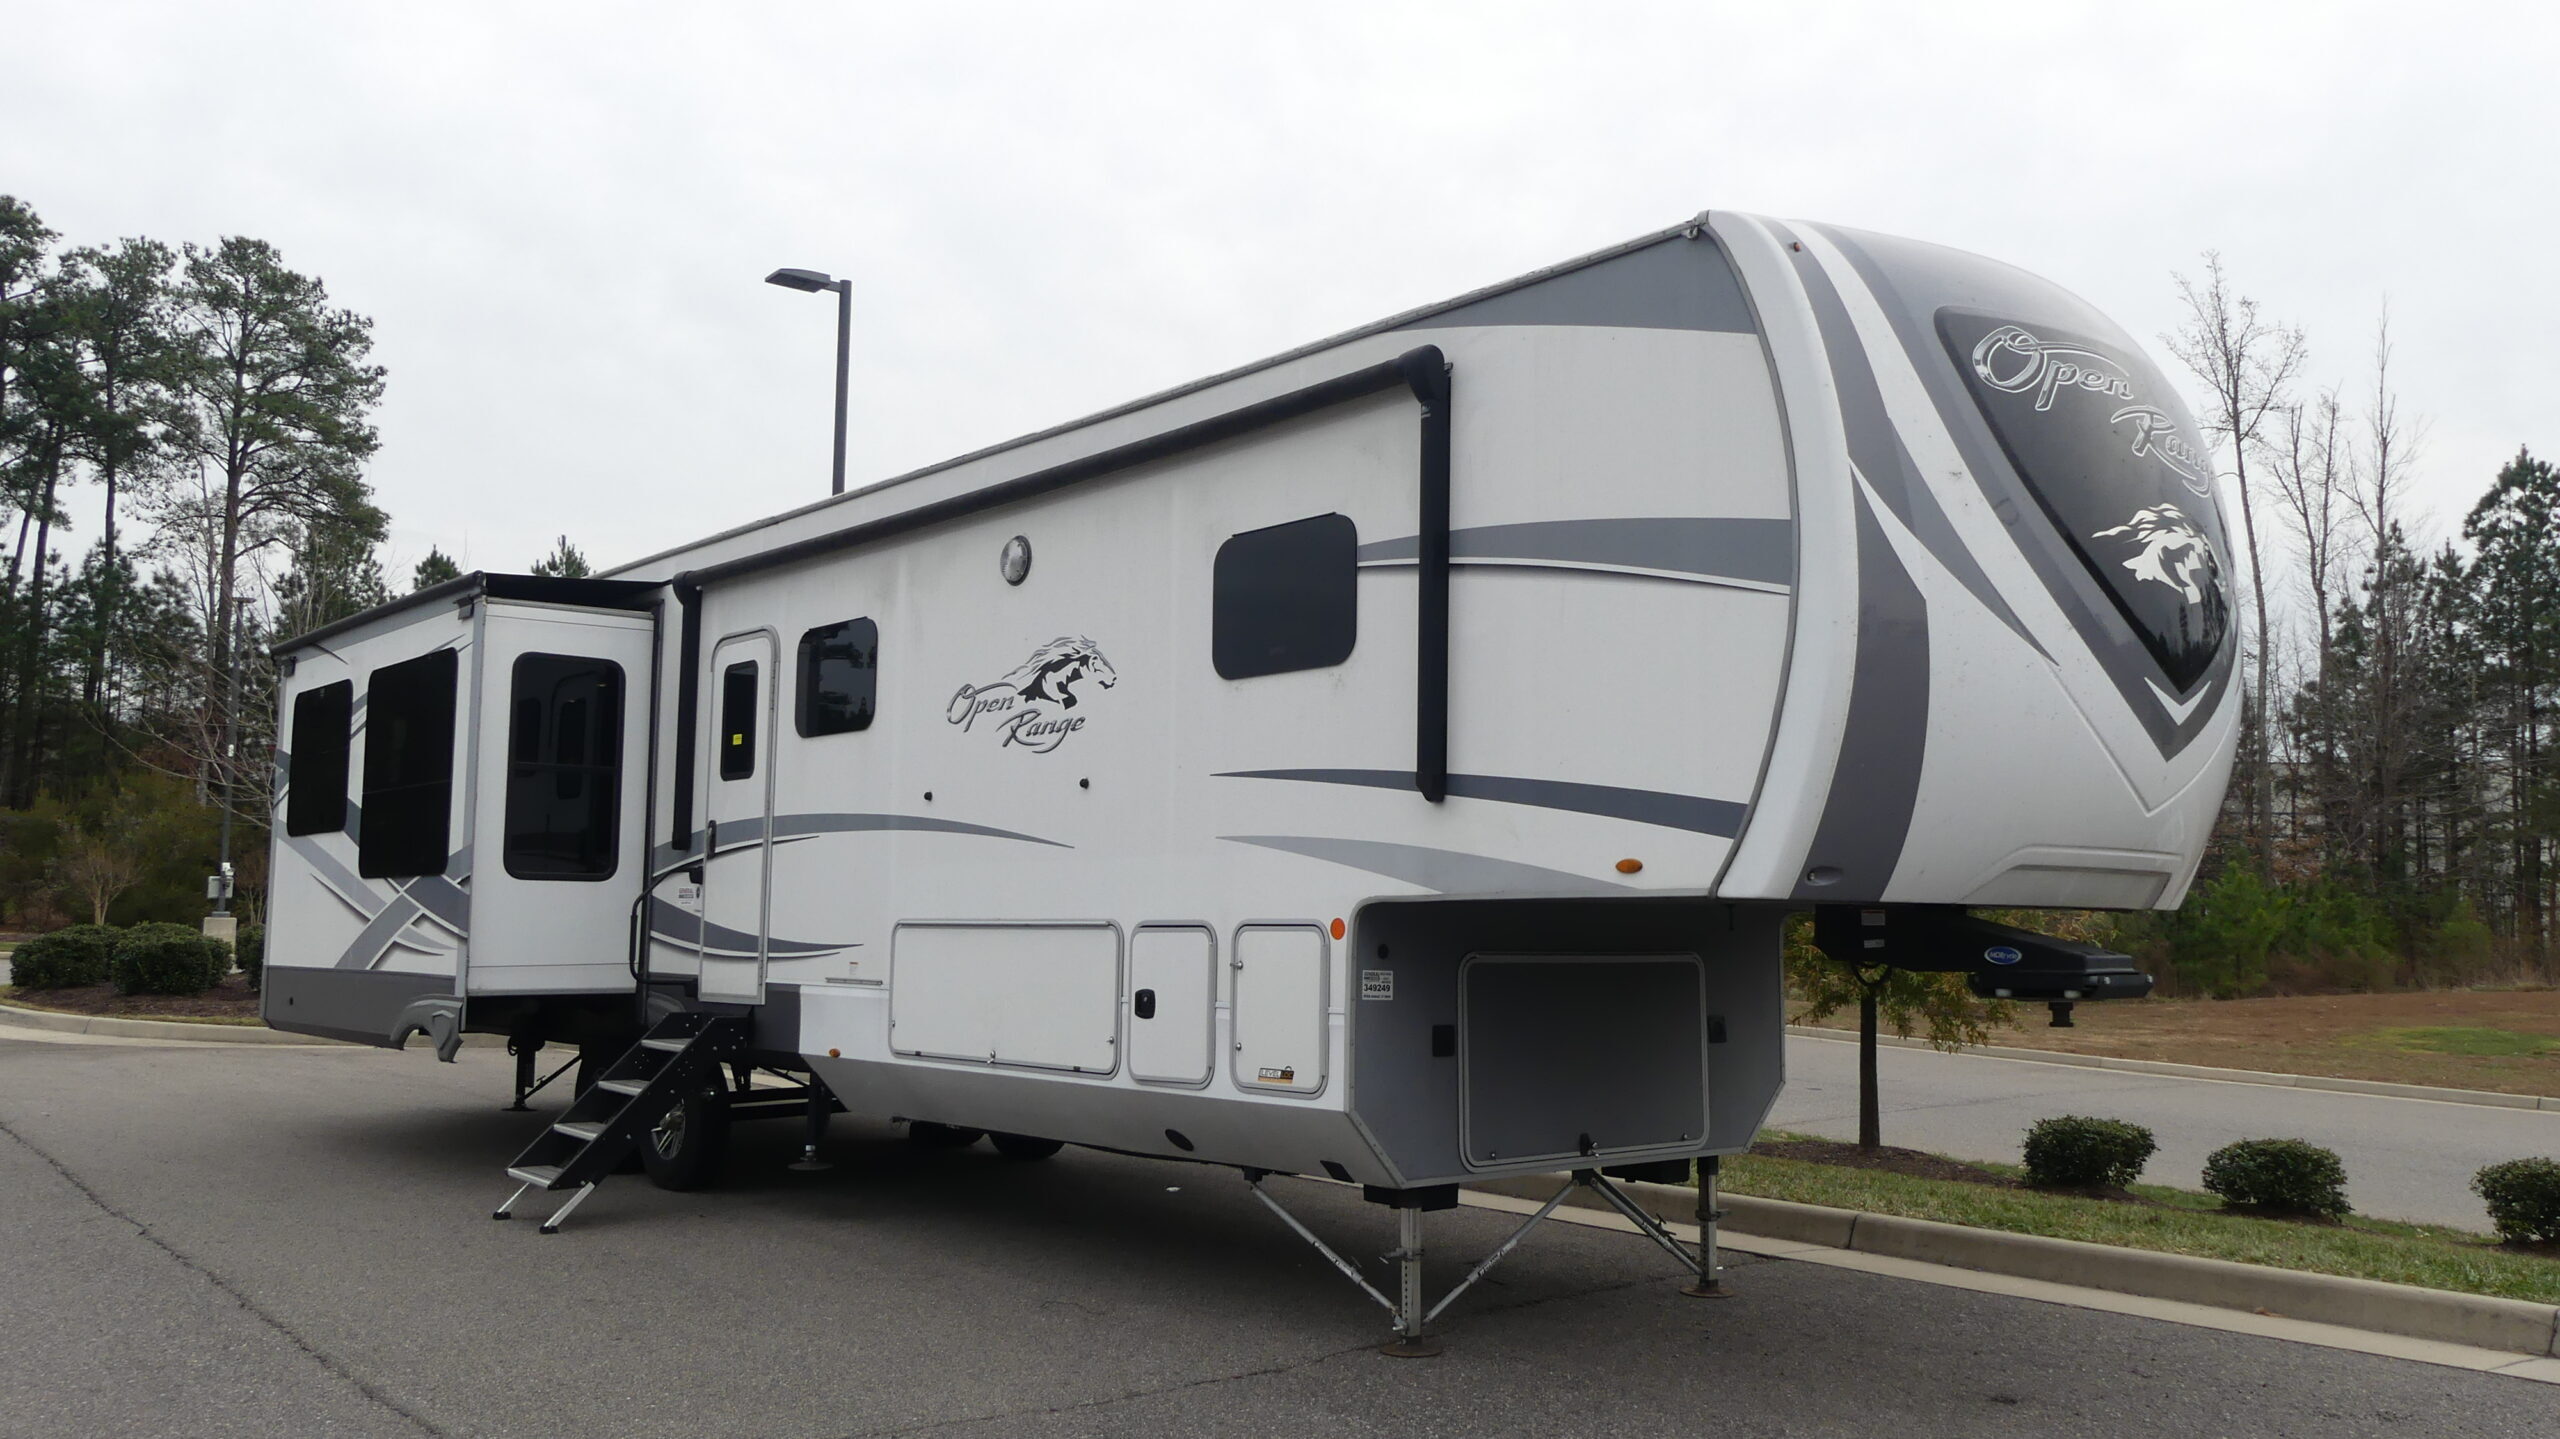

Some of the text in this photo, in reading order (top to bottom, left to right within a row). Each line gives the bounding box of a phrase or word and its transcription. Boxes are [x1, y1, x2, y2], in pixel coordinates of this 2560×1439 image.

[1973, 326, 2134, 411] Open
[947, 683, 1018, 733] Open
[996, 708, 1086, 754] Range
[1363, 983, 1391, 992] 349249
